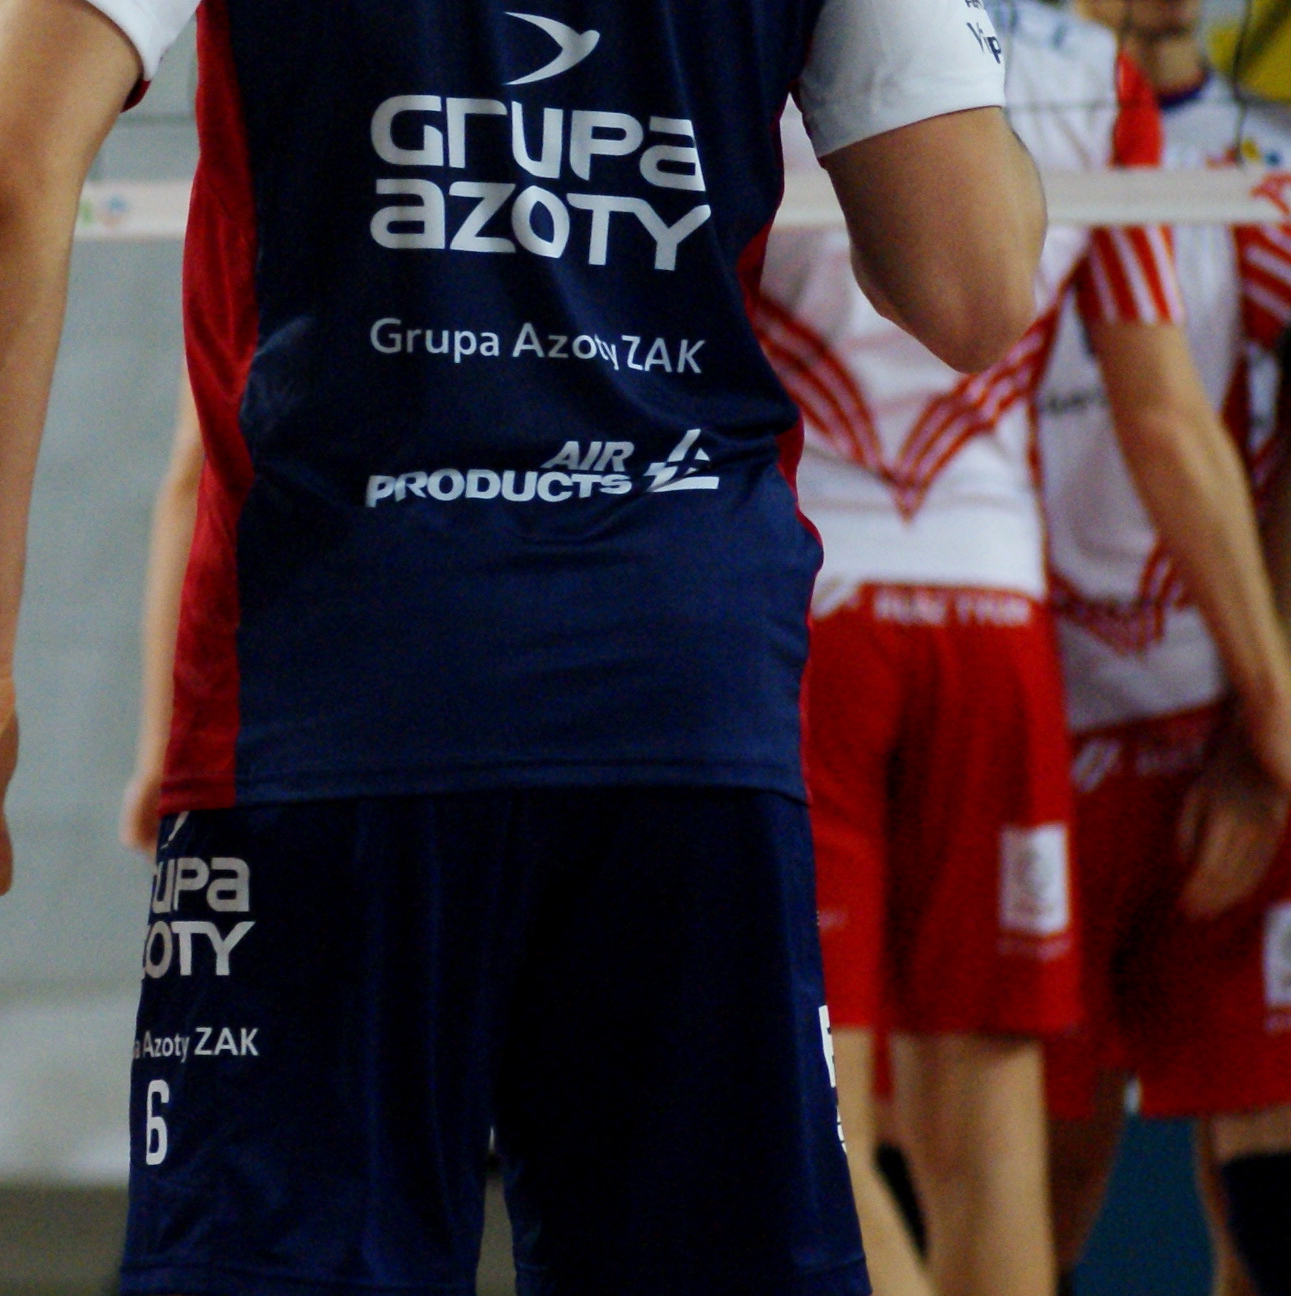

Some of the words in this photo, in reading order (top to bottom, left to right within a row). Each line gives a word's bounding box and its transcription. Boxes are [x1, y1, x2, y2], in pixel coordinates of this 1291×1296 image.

[370, 317, 500, 364] Grupa
[513, 322, 619, 371] Azoty
[621, 334, 706, 374] ZAK
[541, 440, 634, 472] AIR
[365, 468, 633, 508] PRODUCTS
[142, 1030, 190, 1063] Azoty
[194, 1027, 260, 1056] ZAK
[145, 1078, 171, 1166] 6
